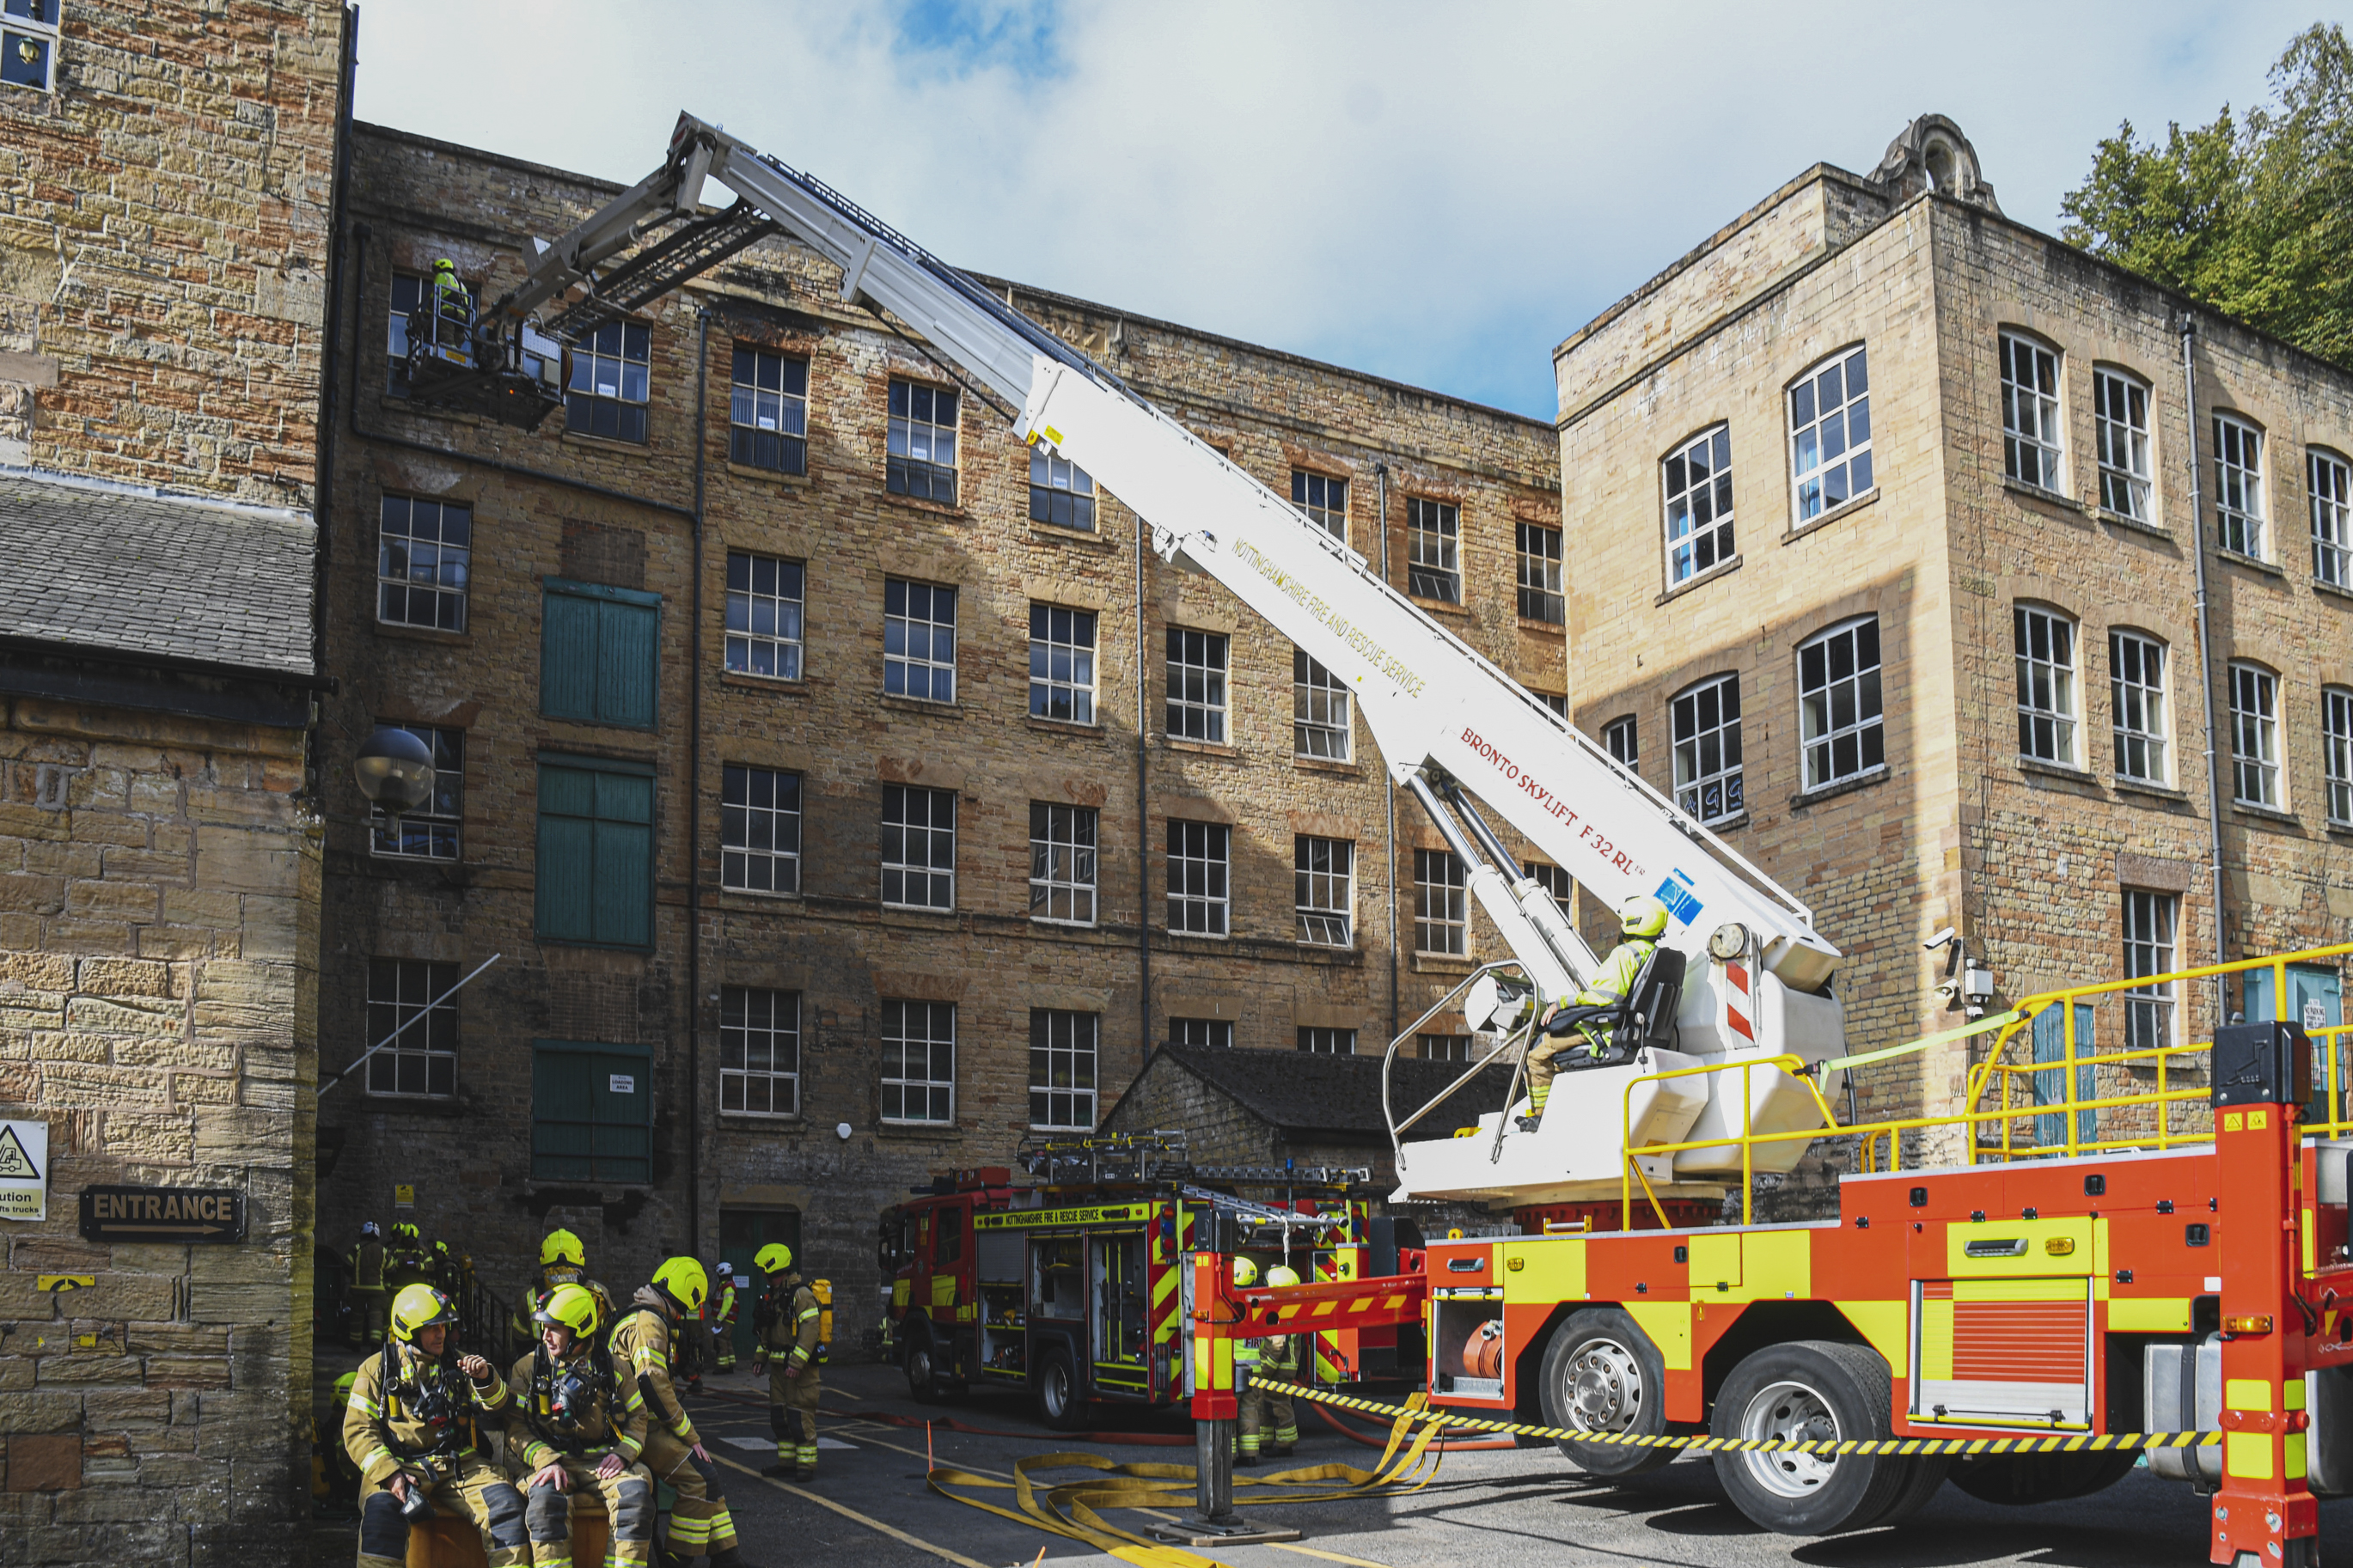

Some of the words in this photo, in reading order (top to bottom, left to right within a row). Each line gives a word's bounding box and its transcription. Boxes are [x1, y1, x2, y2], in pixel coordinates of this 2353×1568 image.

[1232, 537, 1311, 607] NOTTINGHAMSHIRE
[1305, 595, 1330, 622] FIRE
[1325, 613, 1349, 637] AND
[1344, 627, 1386, 668] RESCUE
[1382, 656, 1426, 699] SERVICE
[1461, 727, 1519, 779] BRONTO
[1518, 775, 1579, 827] SKYLIFT
[1580, 824, 1593, 839] F
[1590, 833, 1614, 857] 32
[1611, 851, 1634, 876] RL
[94, 1193, 232, 1221] ENTRANCE
[1005, 1211, 1043, 1226] NOTTINGHAMSHIRE
[1043, 1210, 1054, 1223] FIRE
[1060, 1210, 1078, 1223] RESCUE
[1079, 1208, 1099, 1222] SERVICE
